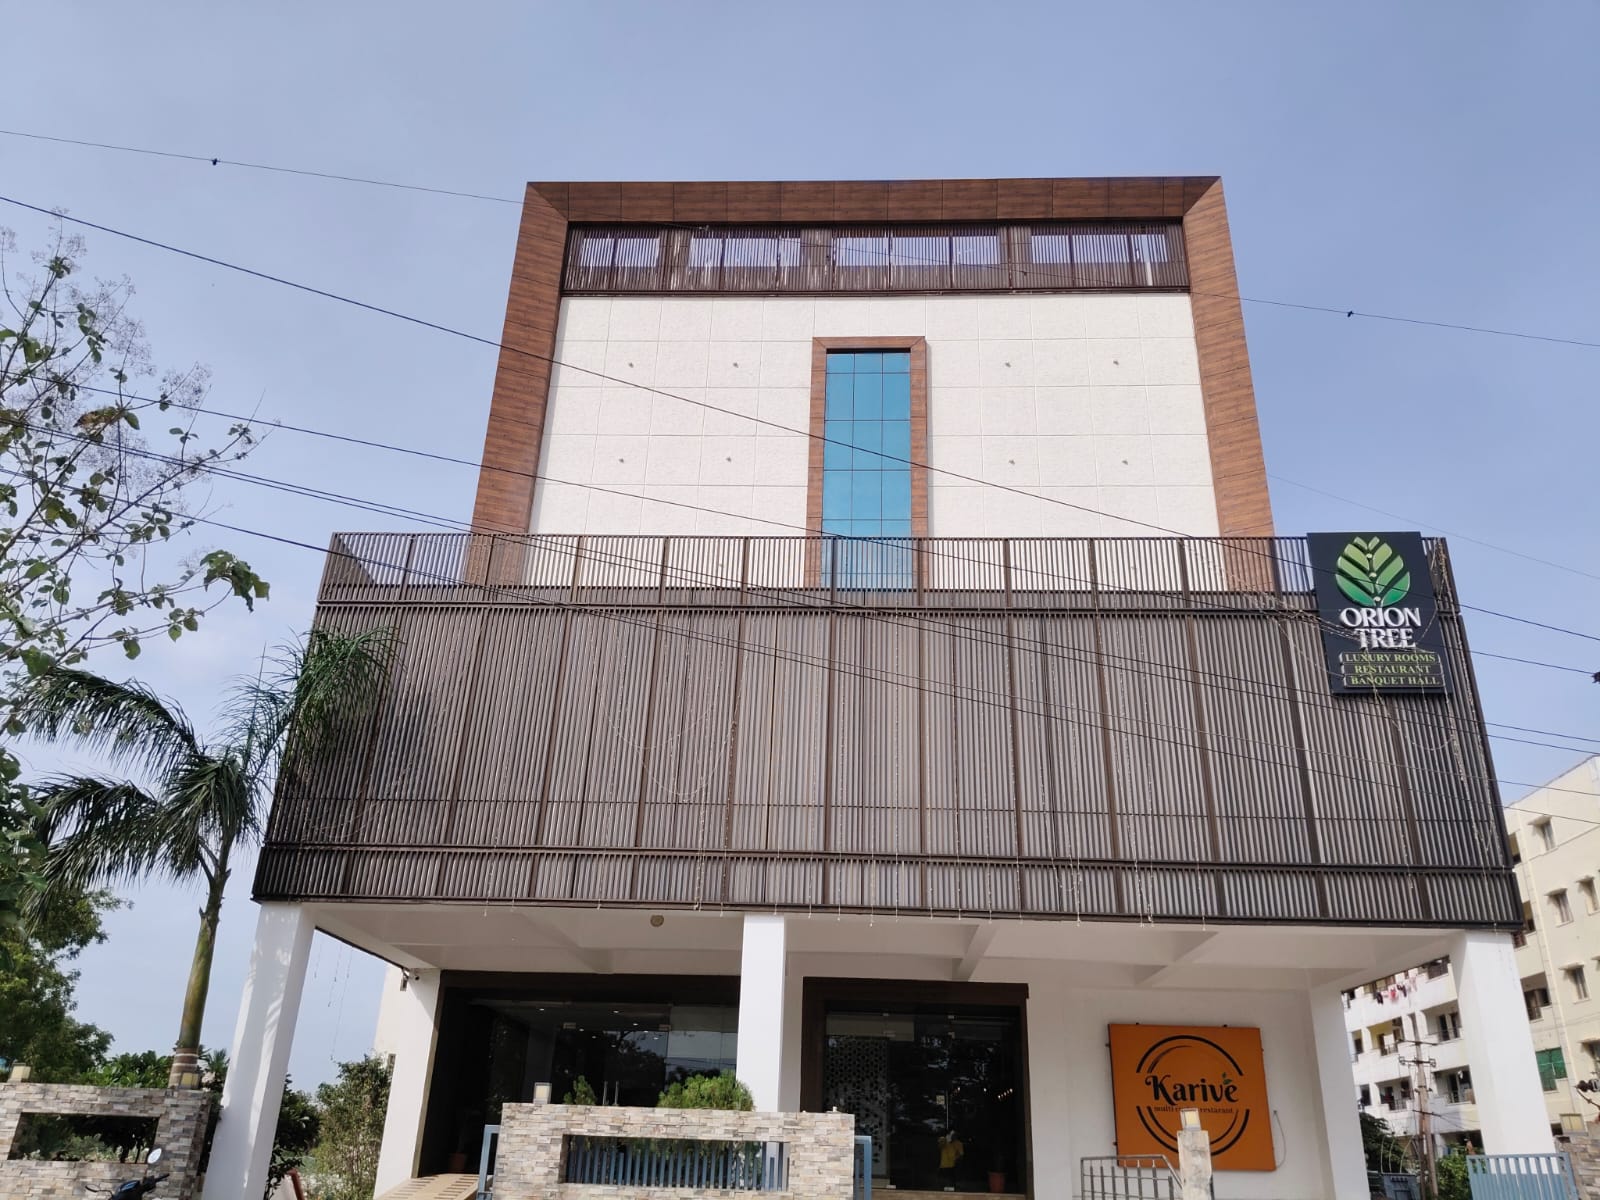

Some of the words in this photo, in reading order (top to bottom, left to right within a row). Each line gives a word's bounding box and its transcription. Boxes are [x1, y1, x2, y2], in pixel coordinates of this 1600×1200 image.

[1339, 607, 1422, 627] ORION
[1354, 628, 1416, 648] TREE
[1345, 653, 1392, 662] LUXURY
[1394, 653, 1436, 662] ROOMS
[1354, 665, 1431, 674] RESTAURANT
[1351, 676, 1405, 686] BANQUET
[1408, 676, 1440, 685] HALL
